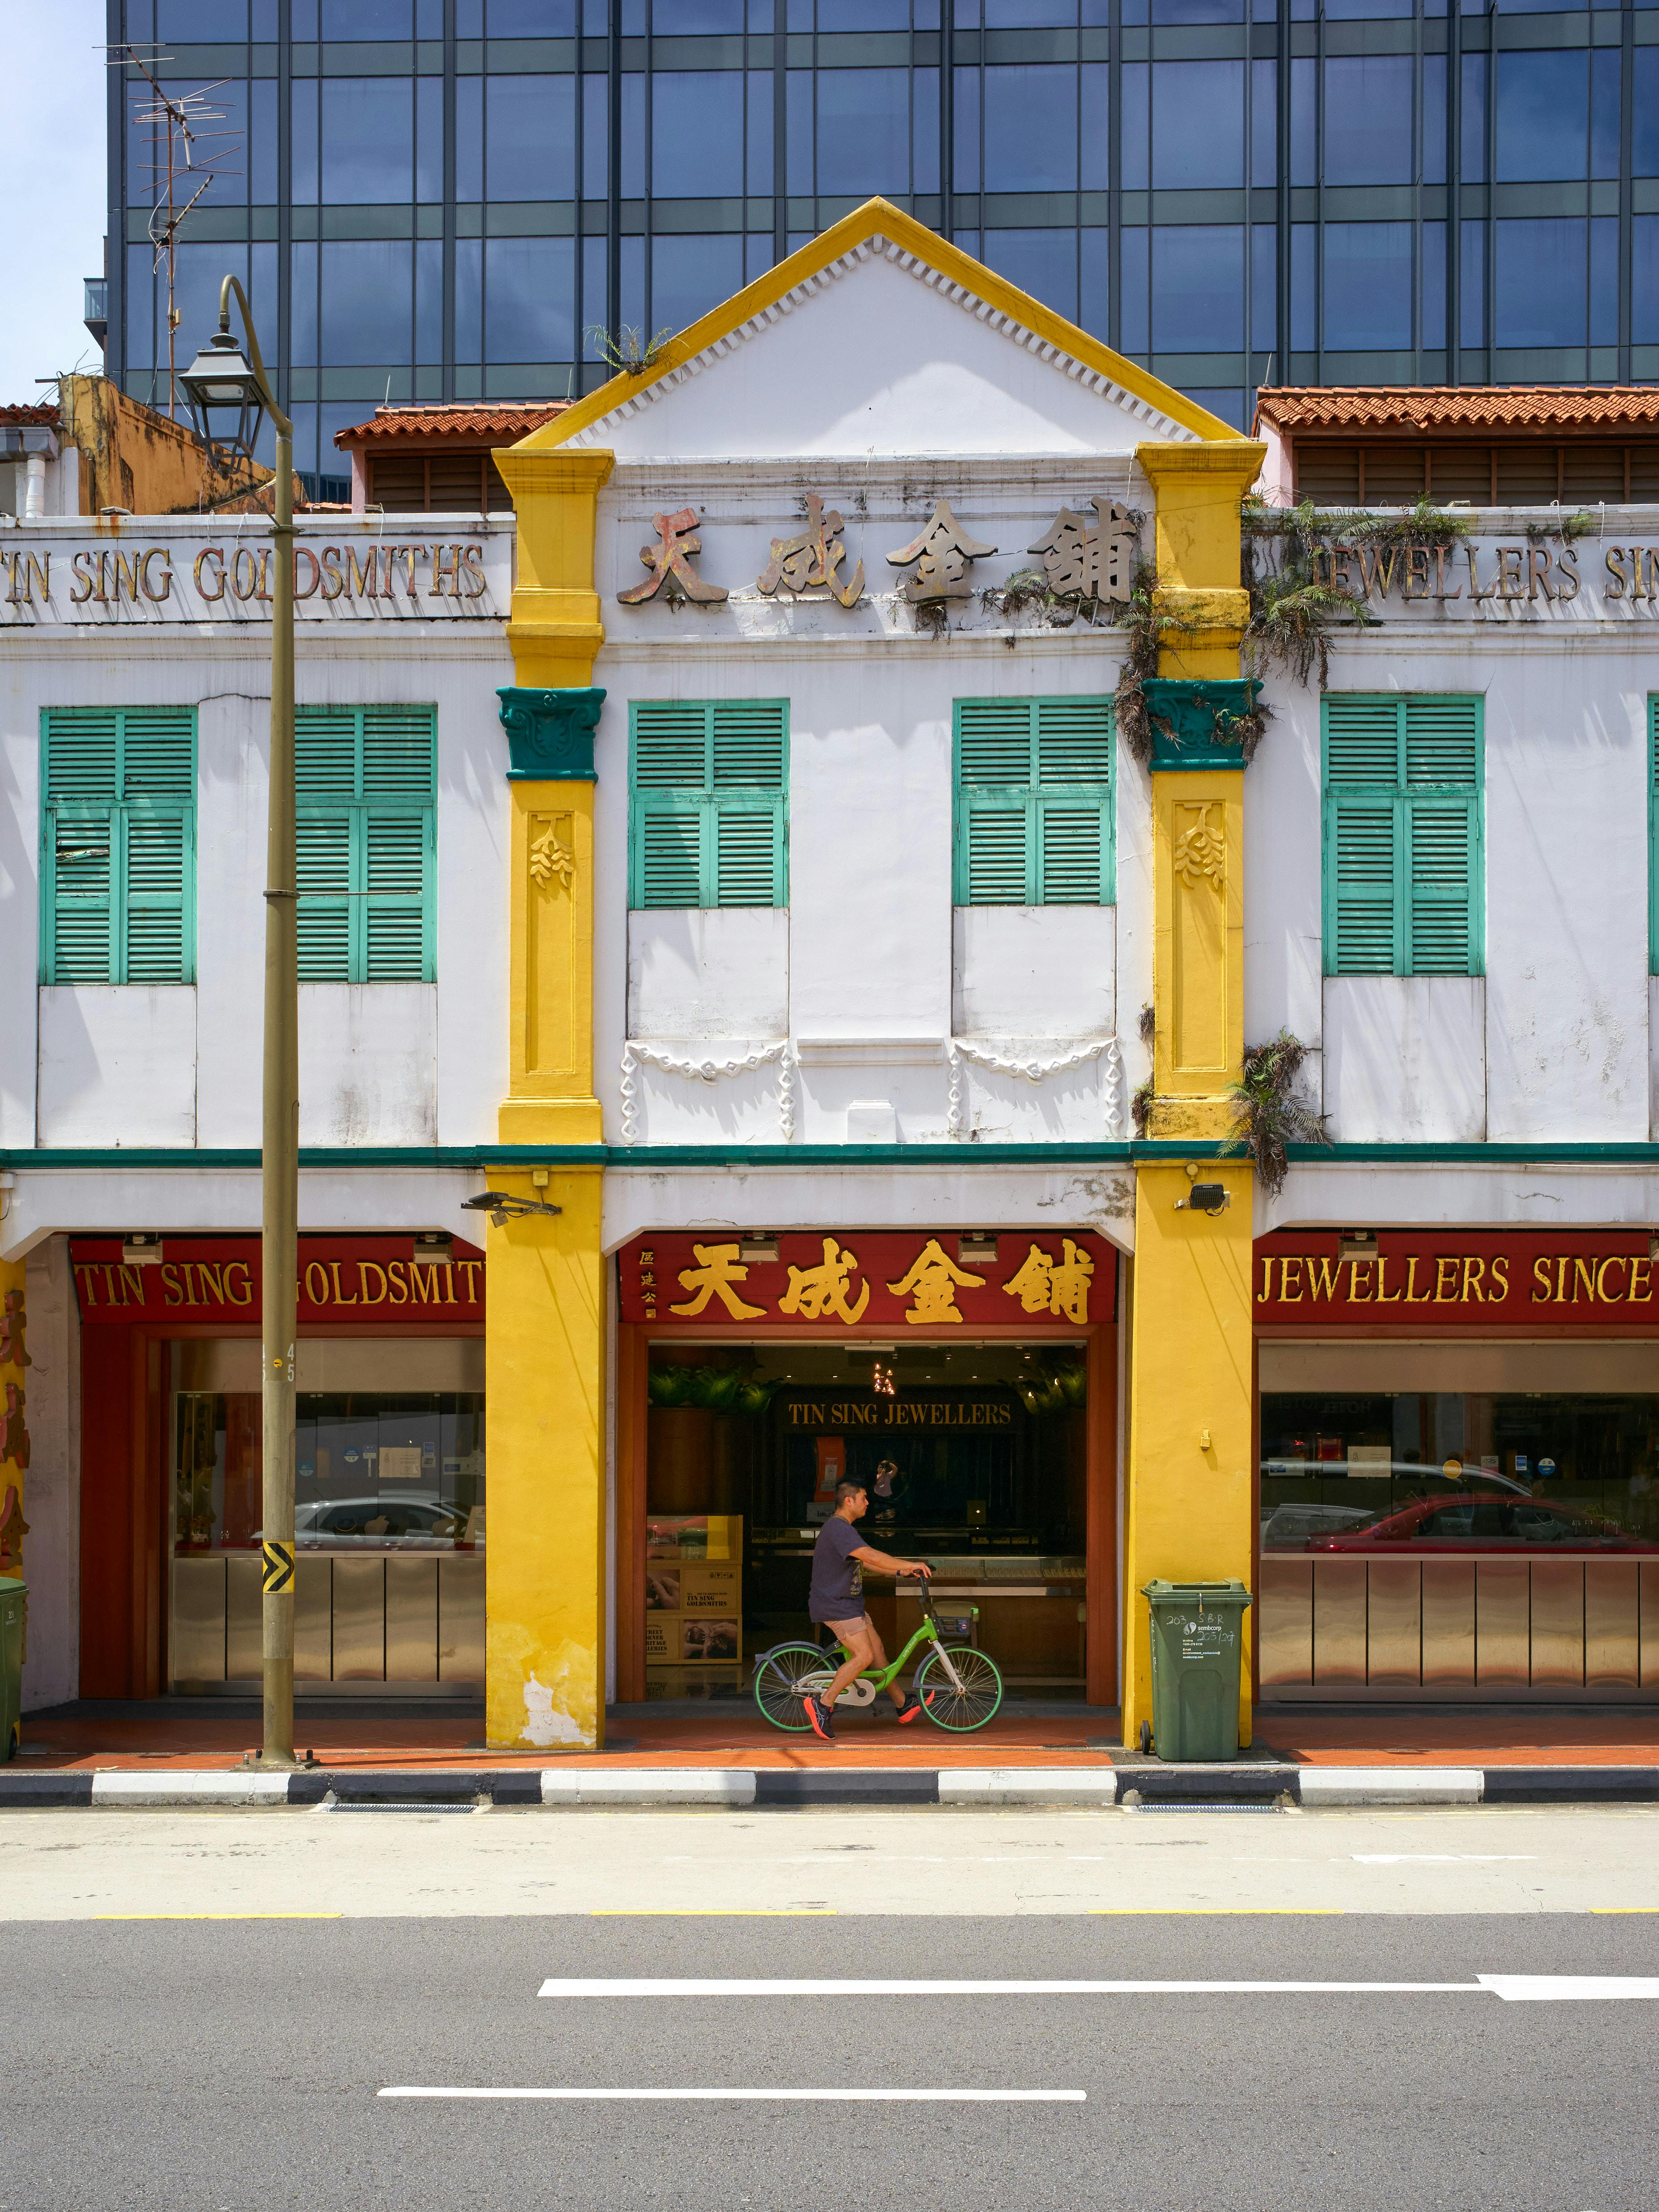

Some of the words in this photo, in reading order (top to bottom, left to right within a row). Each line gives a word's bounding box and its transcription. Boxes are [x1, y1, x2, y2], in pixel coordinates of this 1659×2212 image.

[0, 550, 51, 603] IN
[70, 548, 173, 603] SING
[193, 543, 487, 601] GOLDSMITHS
[75, 1264, 145, 1306] TIN
[166, 1262, 253, 1306] SING
[296, 1260, 486, 1305] OLDSMIT
[669, 1237, 1094, 1324] 天成金鋪
[1257, 1257, 1509, 1303] JEWELLERS
[1532, 1257, 1653, 1303] SINCE
[789, 1404, 826, 1424] TIN
[832, 1404, 878, 1424] SING
[885, 1404, 1011, 1424] JEWELLERS
[1166, 1615, 1187, 1625] 203
